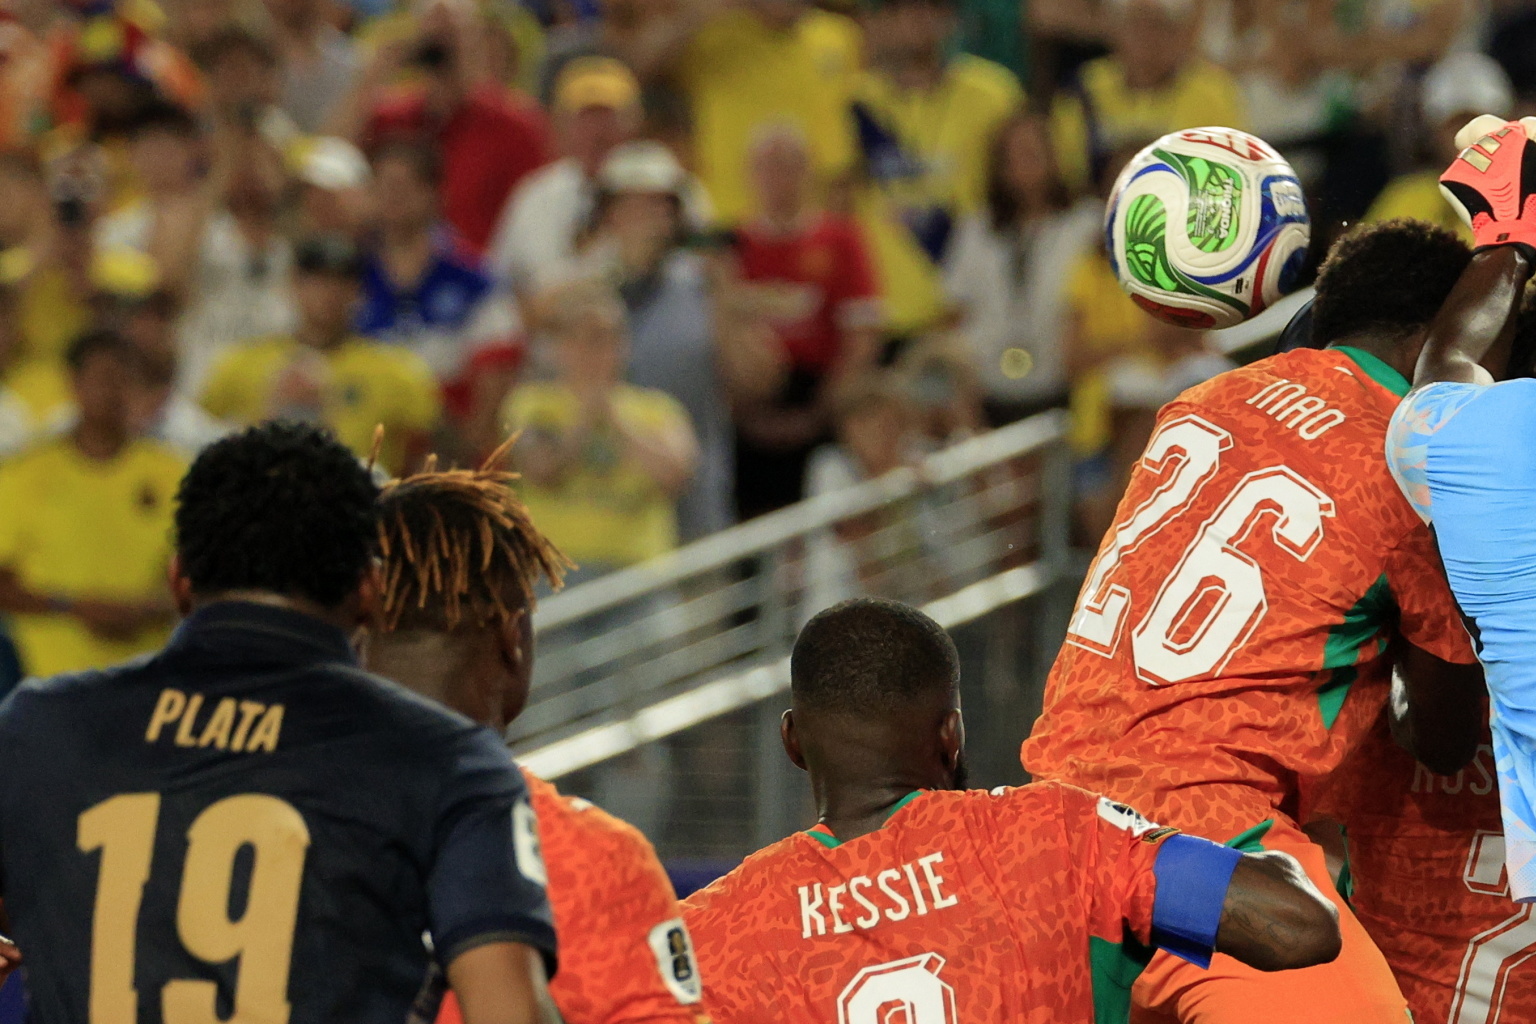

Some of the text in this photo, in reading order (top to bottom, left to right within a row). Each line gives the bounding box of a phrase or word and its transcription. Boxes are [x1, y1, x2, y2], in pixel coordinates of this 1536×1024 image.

[1219, 177, 1234, 239] TRIONDA
[1066, 413, 1336, 686] 26
[145, 688, 287, 753] PLATA
[797, 851, 958, 939] KESSIE
